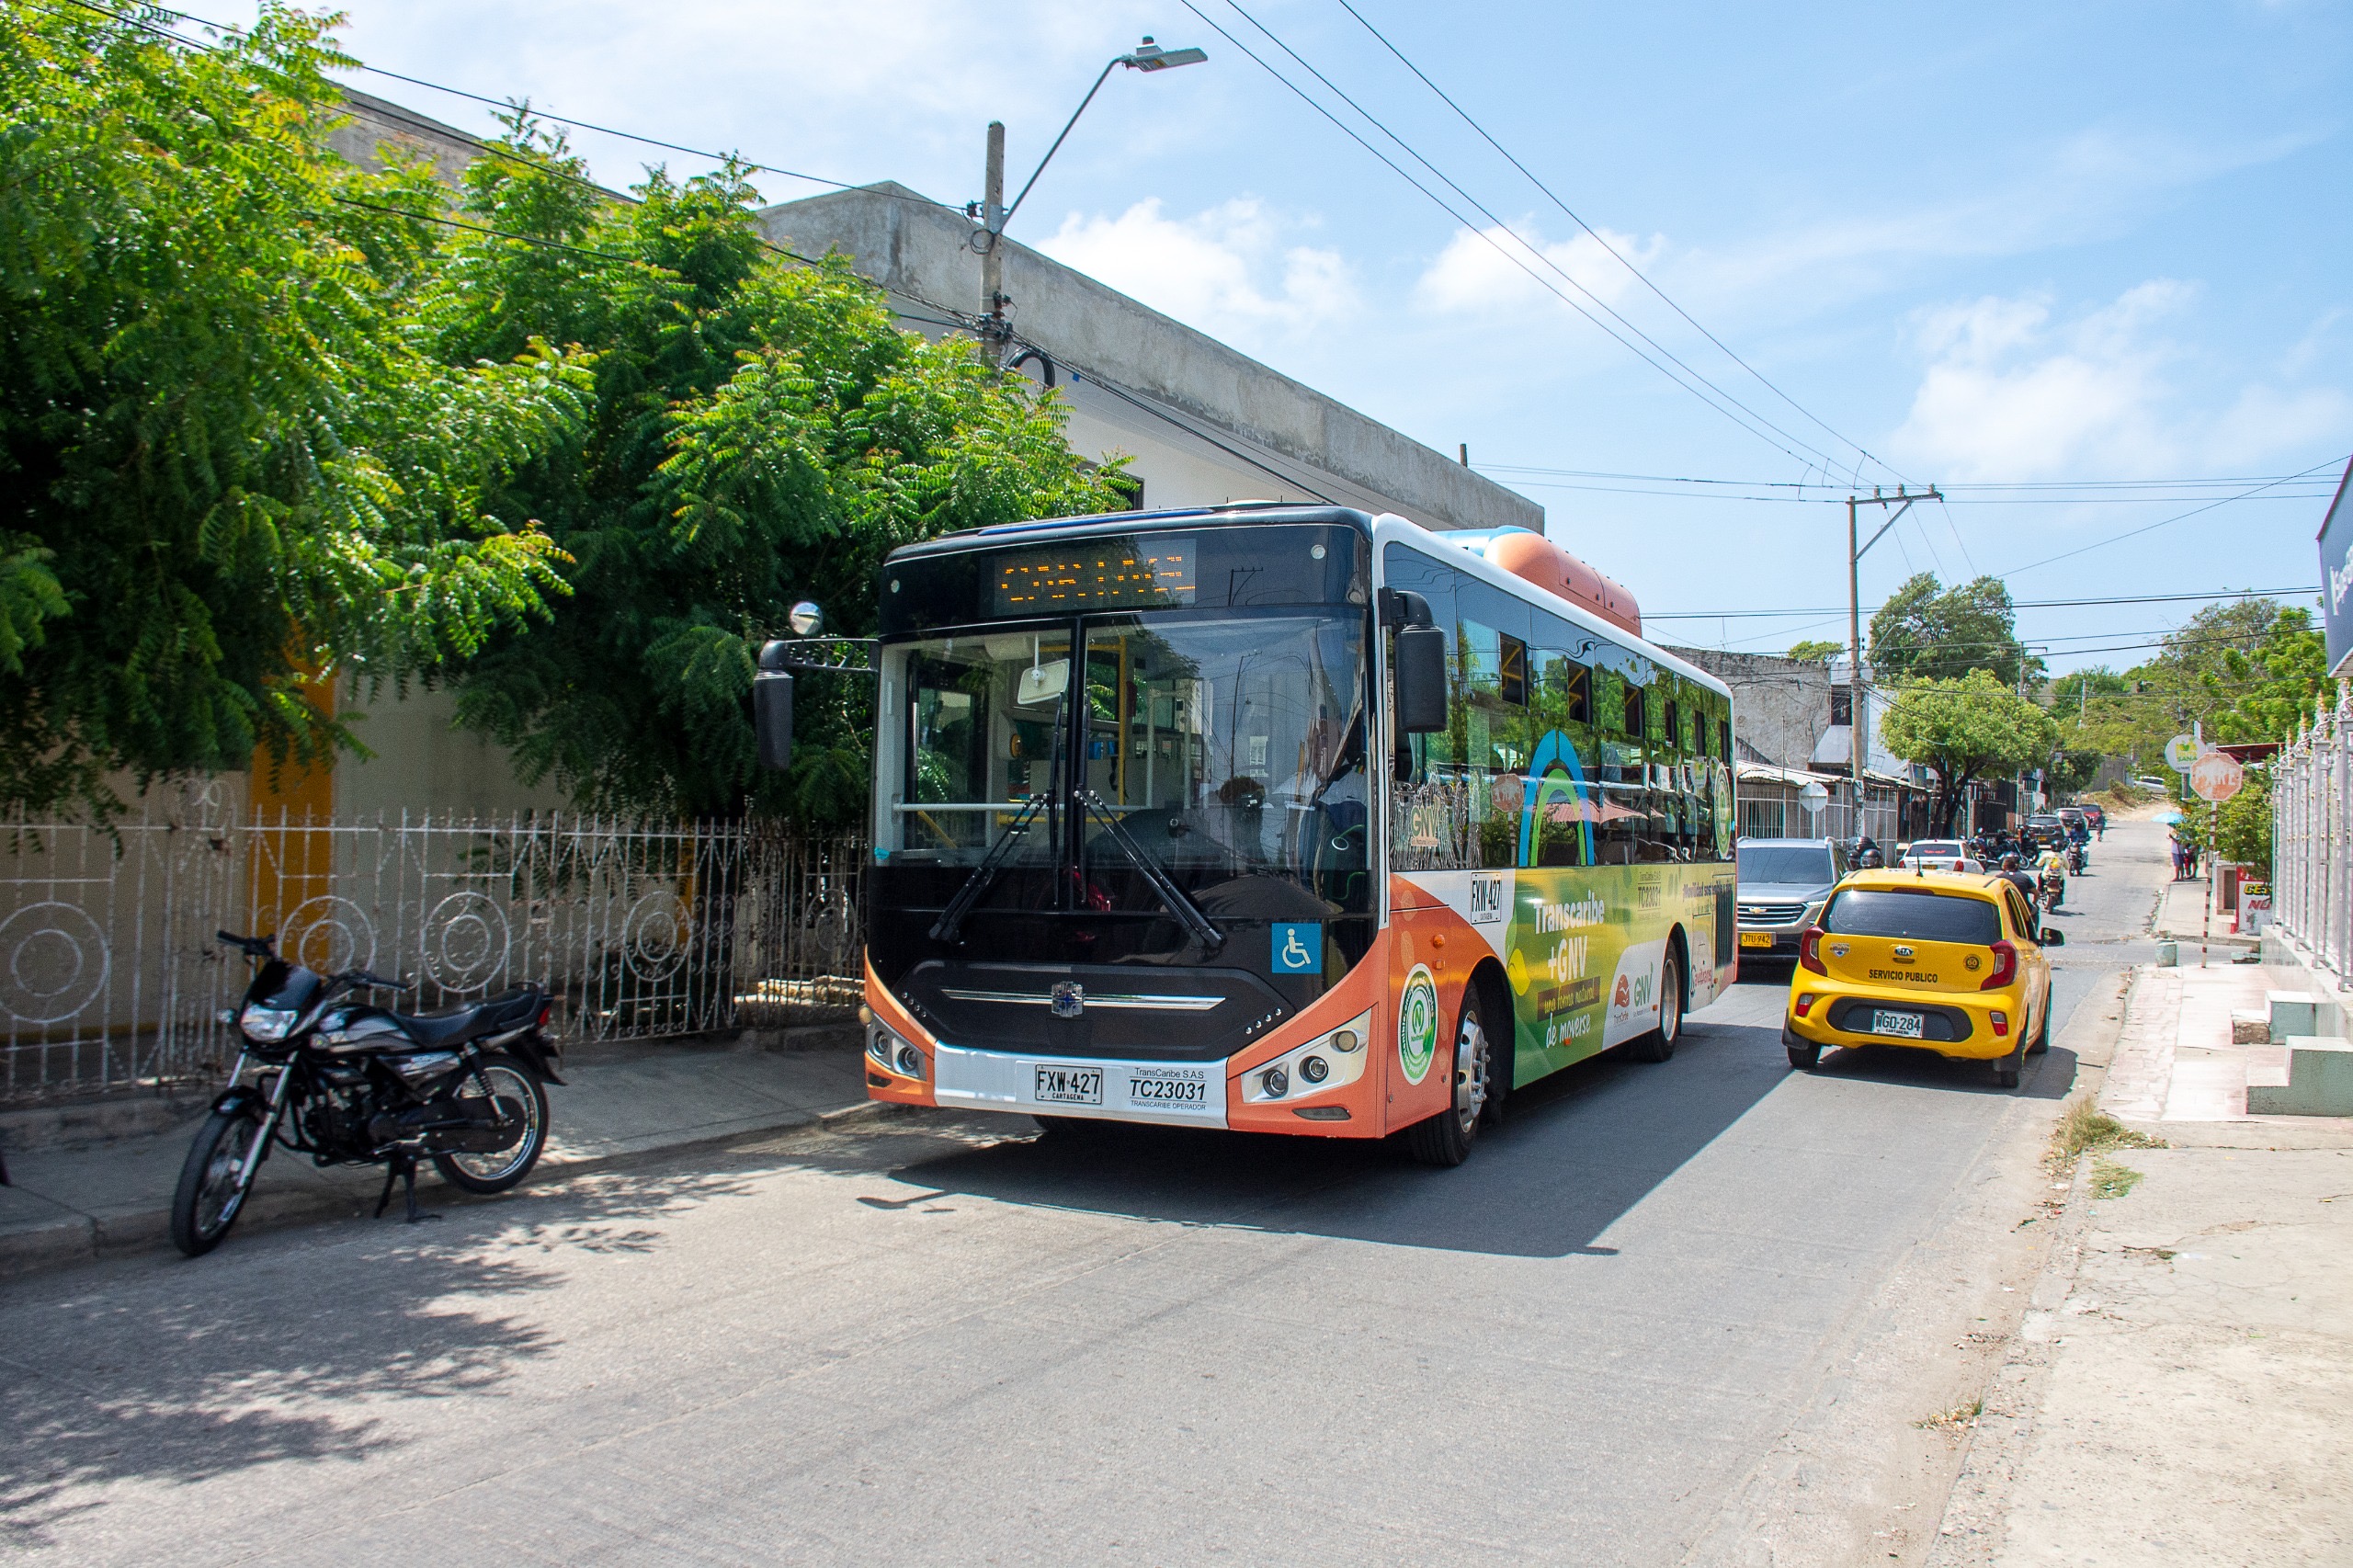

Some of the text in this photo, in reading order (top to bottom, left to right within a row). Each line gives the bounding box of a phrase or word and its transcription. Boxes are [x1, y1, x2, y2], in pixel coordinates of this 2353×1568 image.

[1533, 890, 1605, 935] Transcaribe
[1548, 936, 1588, 983] +GNV
[1896, 948, 1912, 956] KIA
[1869, 969, 1938, 983] SERVICIO PUBLICO
[1634, 972, 1652, 1007] GNV
[1545, 1012, 1591, 1049] de moverse
[1135, 1067, 1181, 1078] TransCaribe
[1051, 1093, 1085, 1101] CARTAGENA
[1130, 1079, 1206, 1101] TC23031
[1131, 1100, 1171, 1109] TRANSCARIBE
